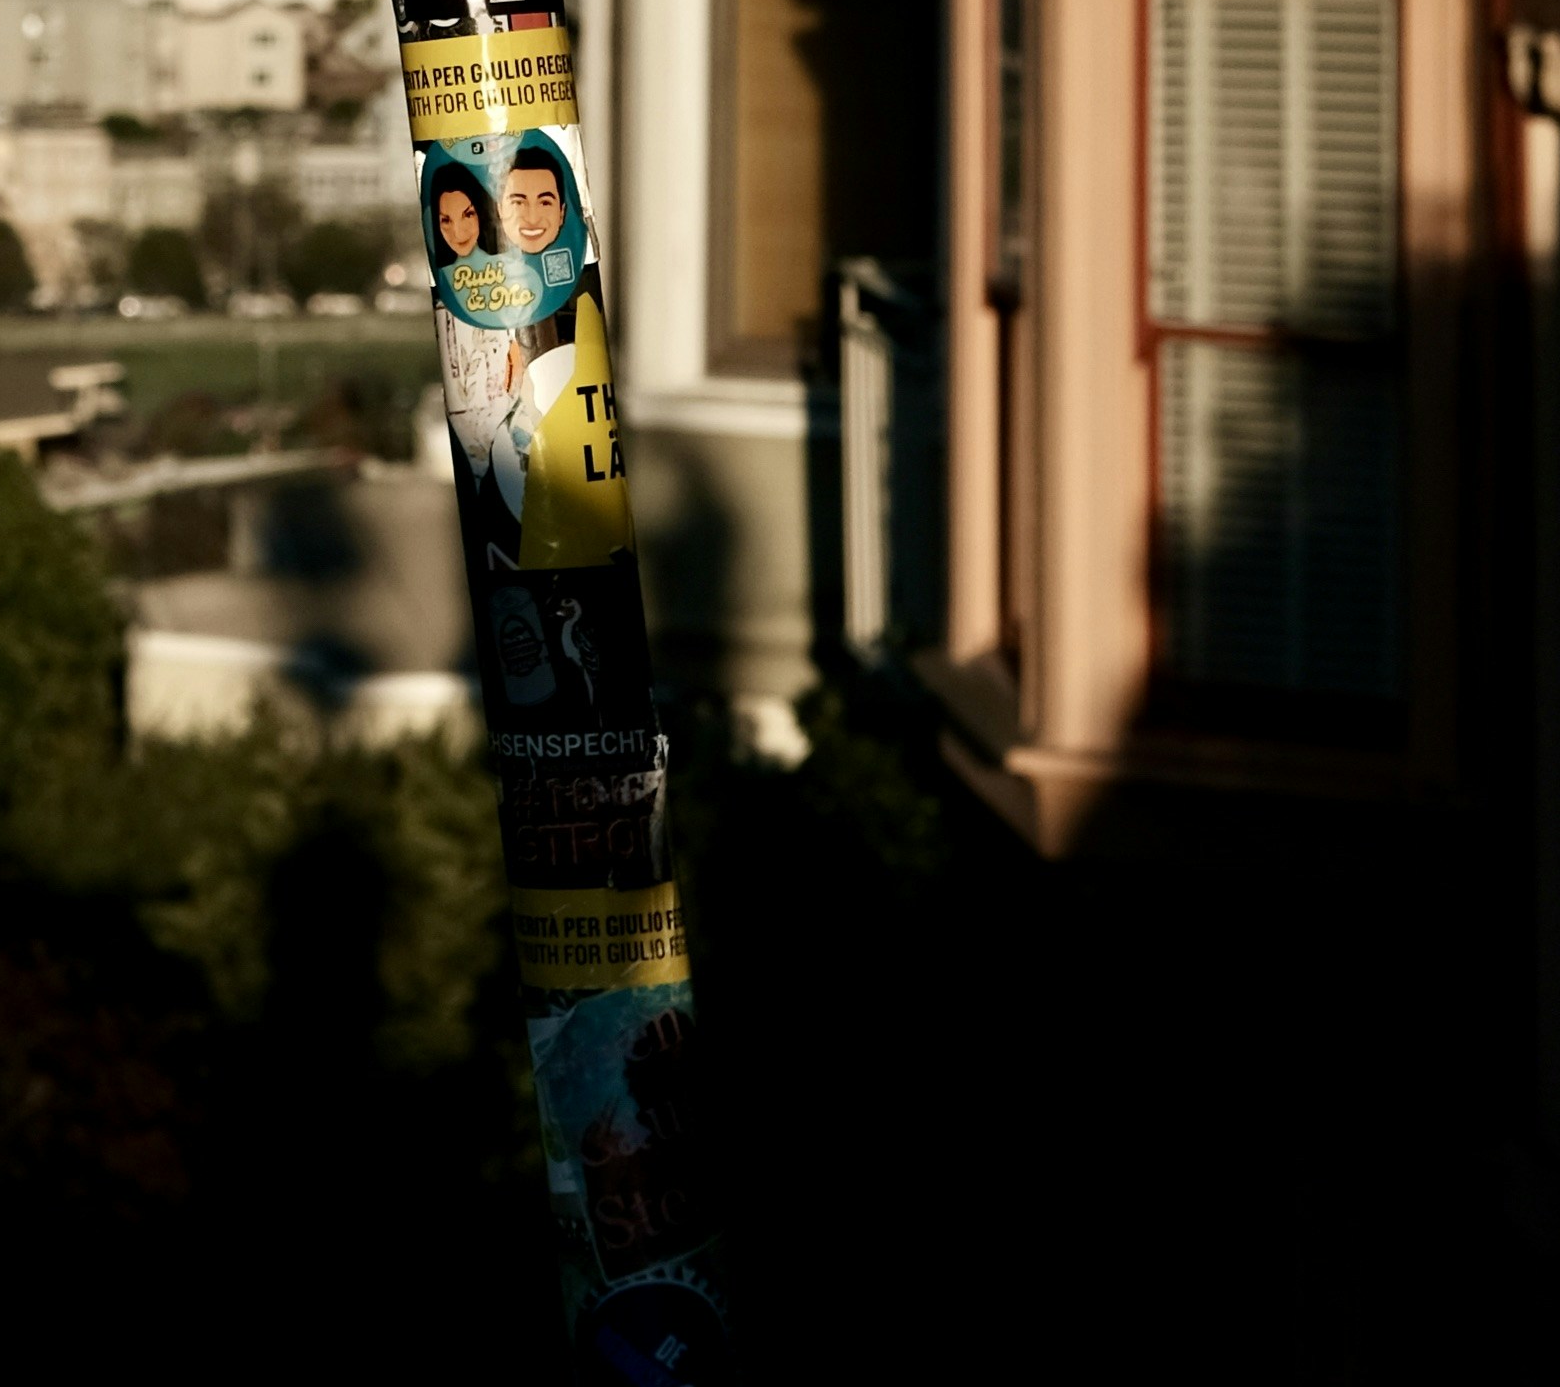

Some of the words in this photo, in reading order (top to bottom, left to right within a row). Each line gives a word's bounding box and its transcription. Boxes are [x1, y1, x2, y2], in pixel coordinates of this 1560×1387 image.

[433, 63, 466, 87] PER
[435, 93, 468, 113] FOR
[453, 262, 506, 291] Rubi
[489, 284, 535, 312] Mo
